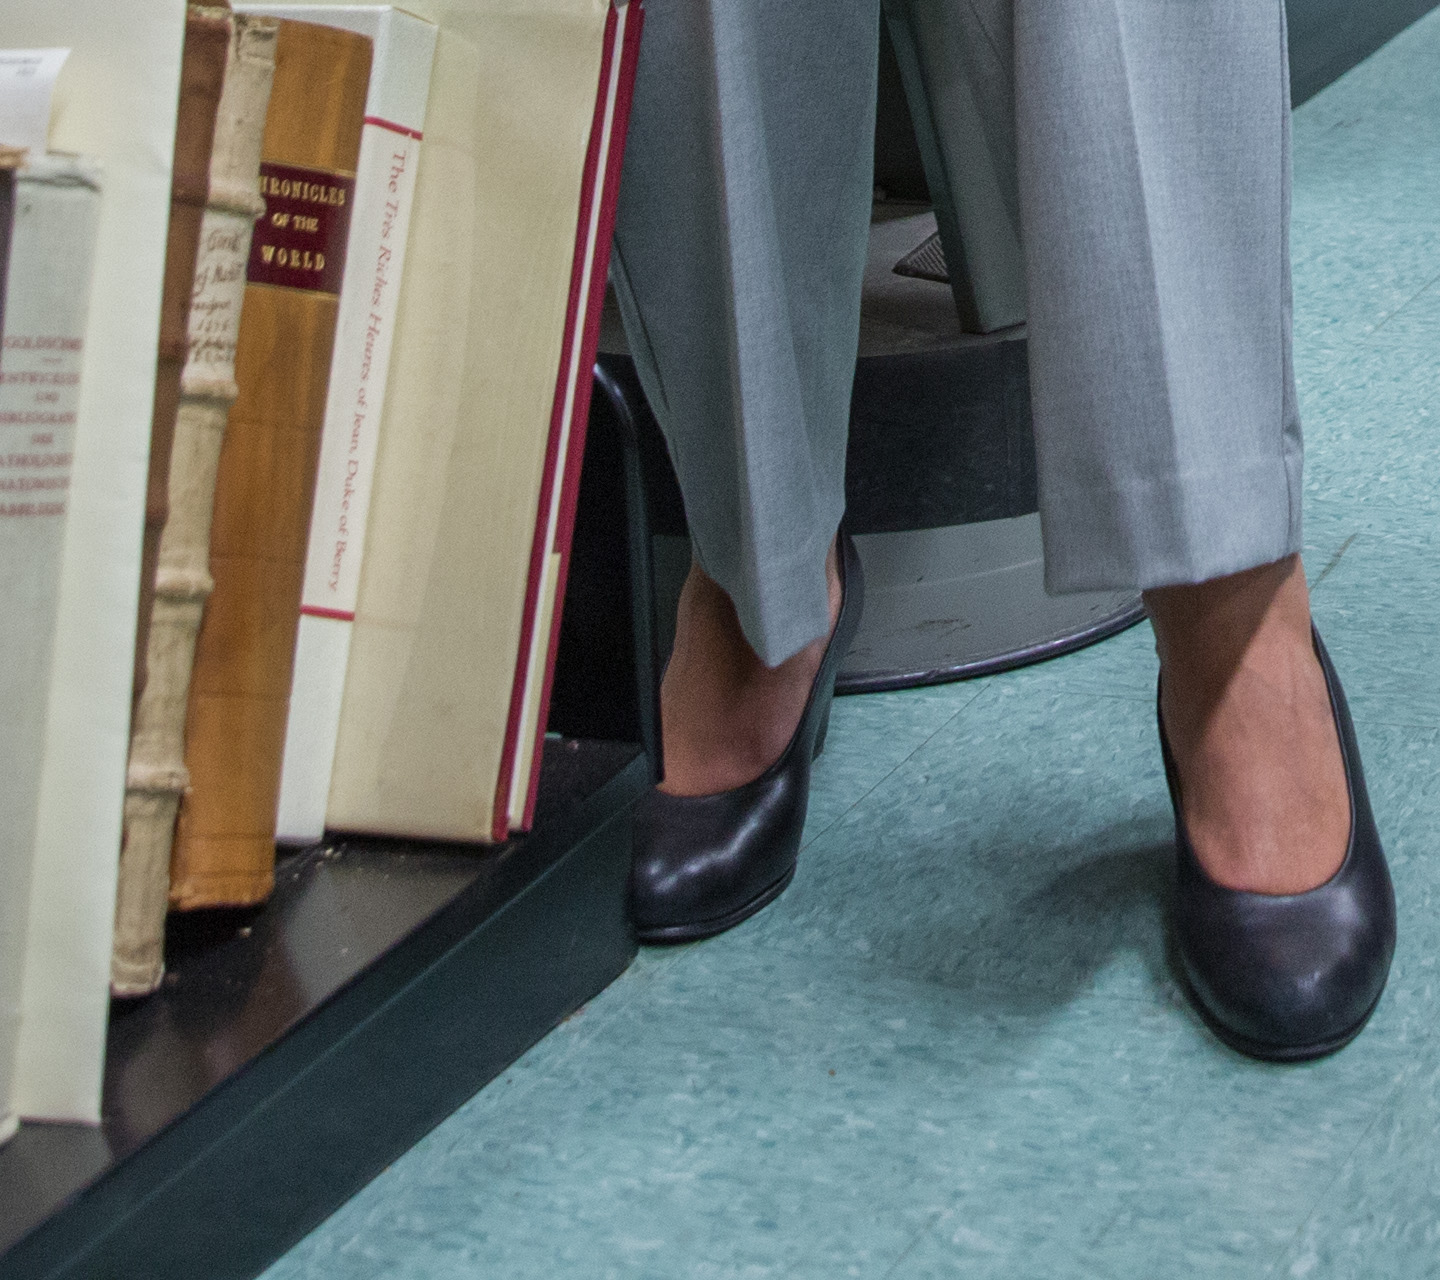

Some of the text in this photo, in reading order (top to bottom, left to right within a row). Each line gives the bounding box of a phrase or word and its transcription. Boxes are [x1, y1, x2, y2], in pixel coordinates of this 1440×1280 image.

[387, 149, 408, 193] The
[259, 175, 347, 207] HRONICLES
[271, 212, 319, 233] OF THE
[260, 244, 326, 272] WORLD
[371, 245, 392, 307] Riches
[360, 313, 382, 381] Heures
[357, 387, 368, 408] of
[342, 459, 359, 509] Duke
[337, 514, 349, 535] of
[328, 539, 348, 592] Berry
